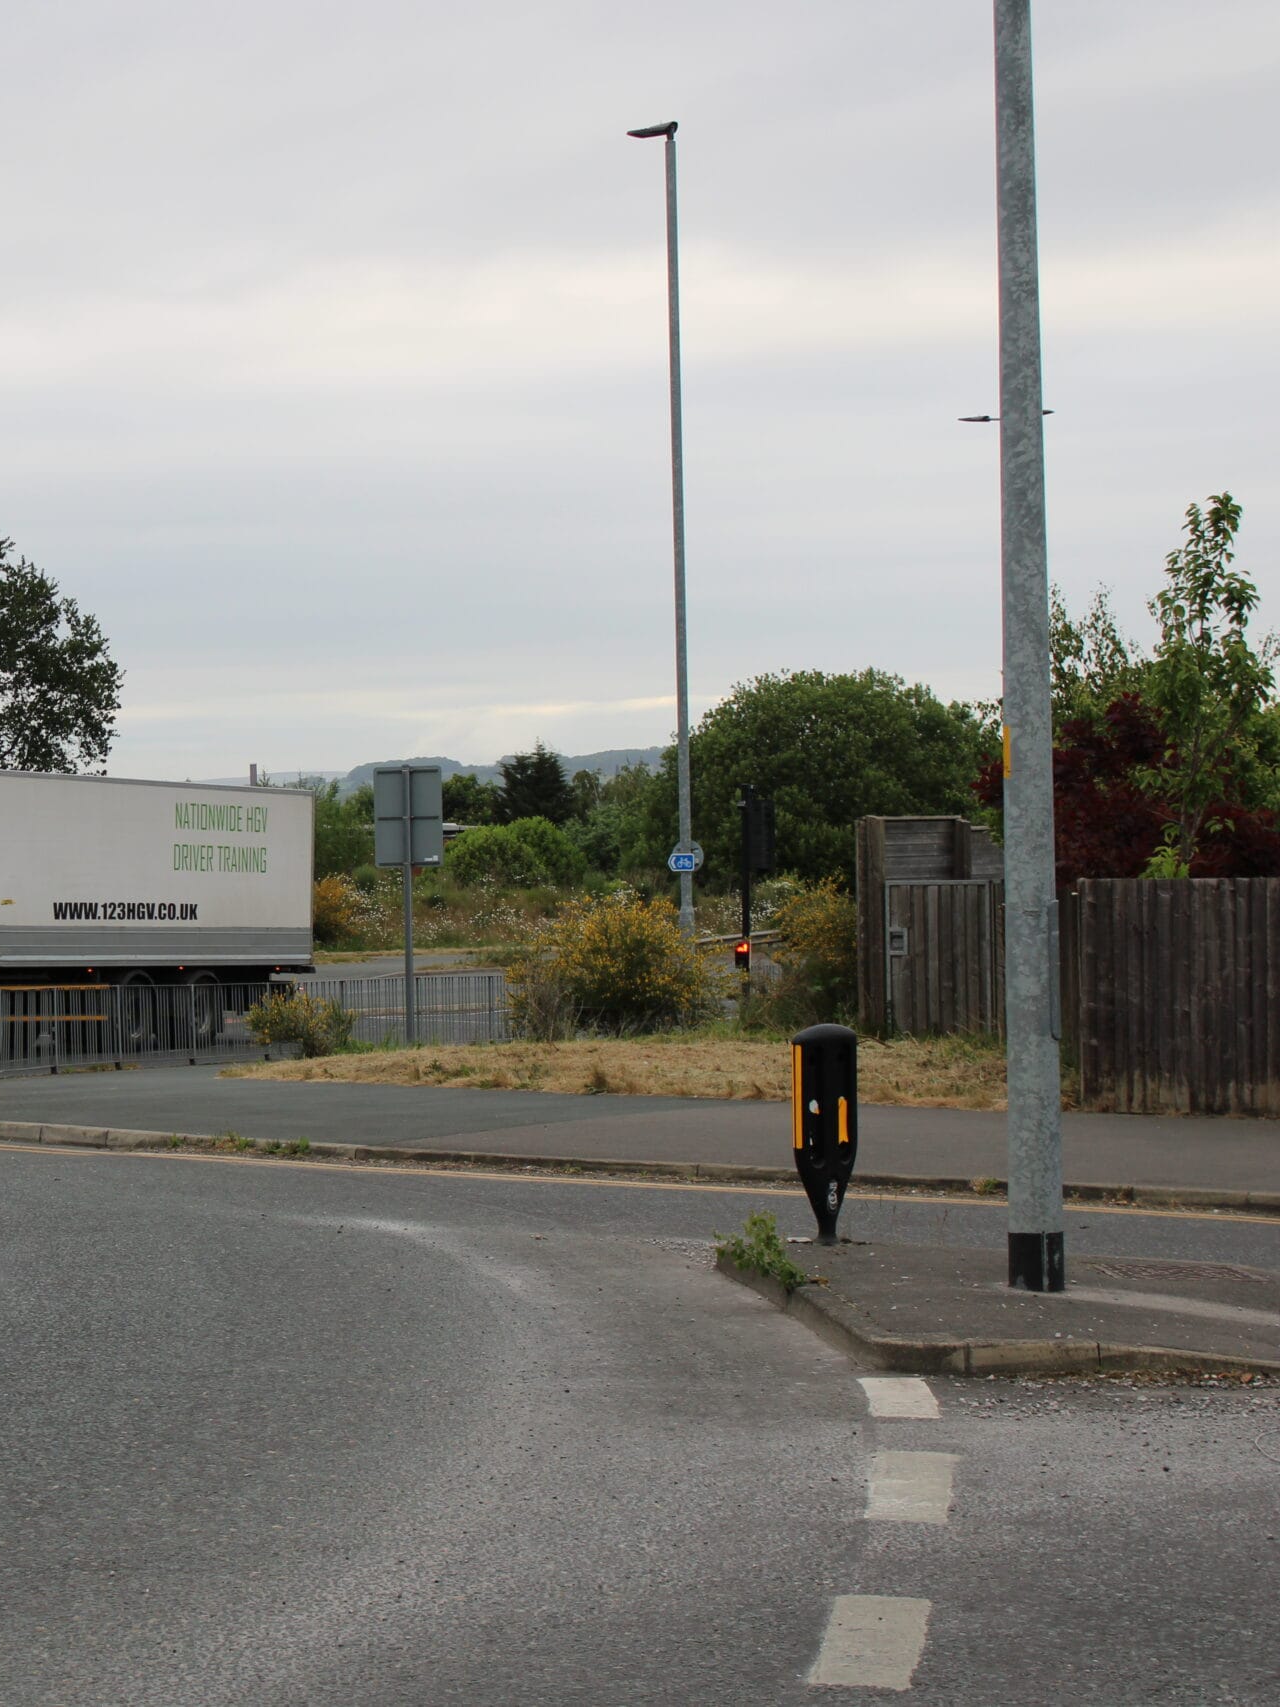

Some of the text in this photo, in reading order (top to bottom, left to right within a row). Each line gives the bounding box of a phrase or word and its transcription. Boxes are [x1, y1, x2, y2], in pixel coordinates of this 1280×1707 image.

[175, 802, 268, 833] NATIONWIDE HGV
[173, 843, 267, 873] DRIVER TRAINING
[53, 901, 198, 920] WWW.123HGV.CO.UK
